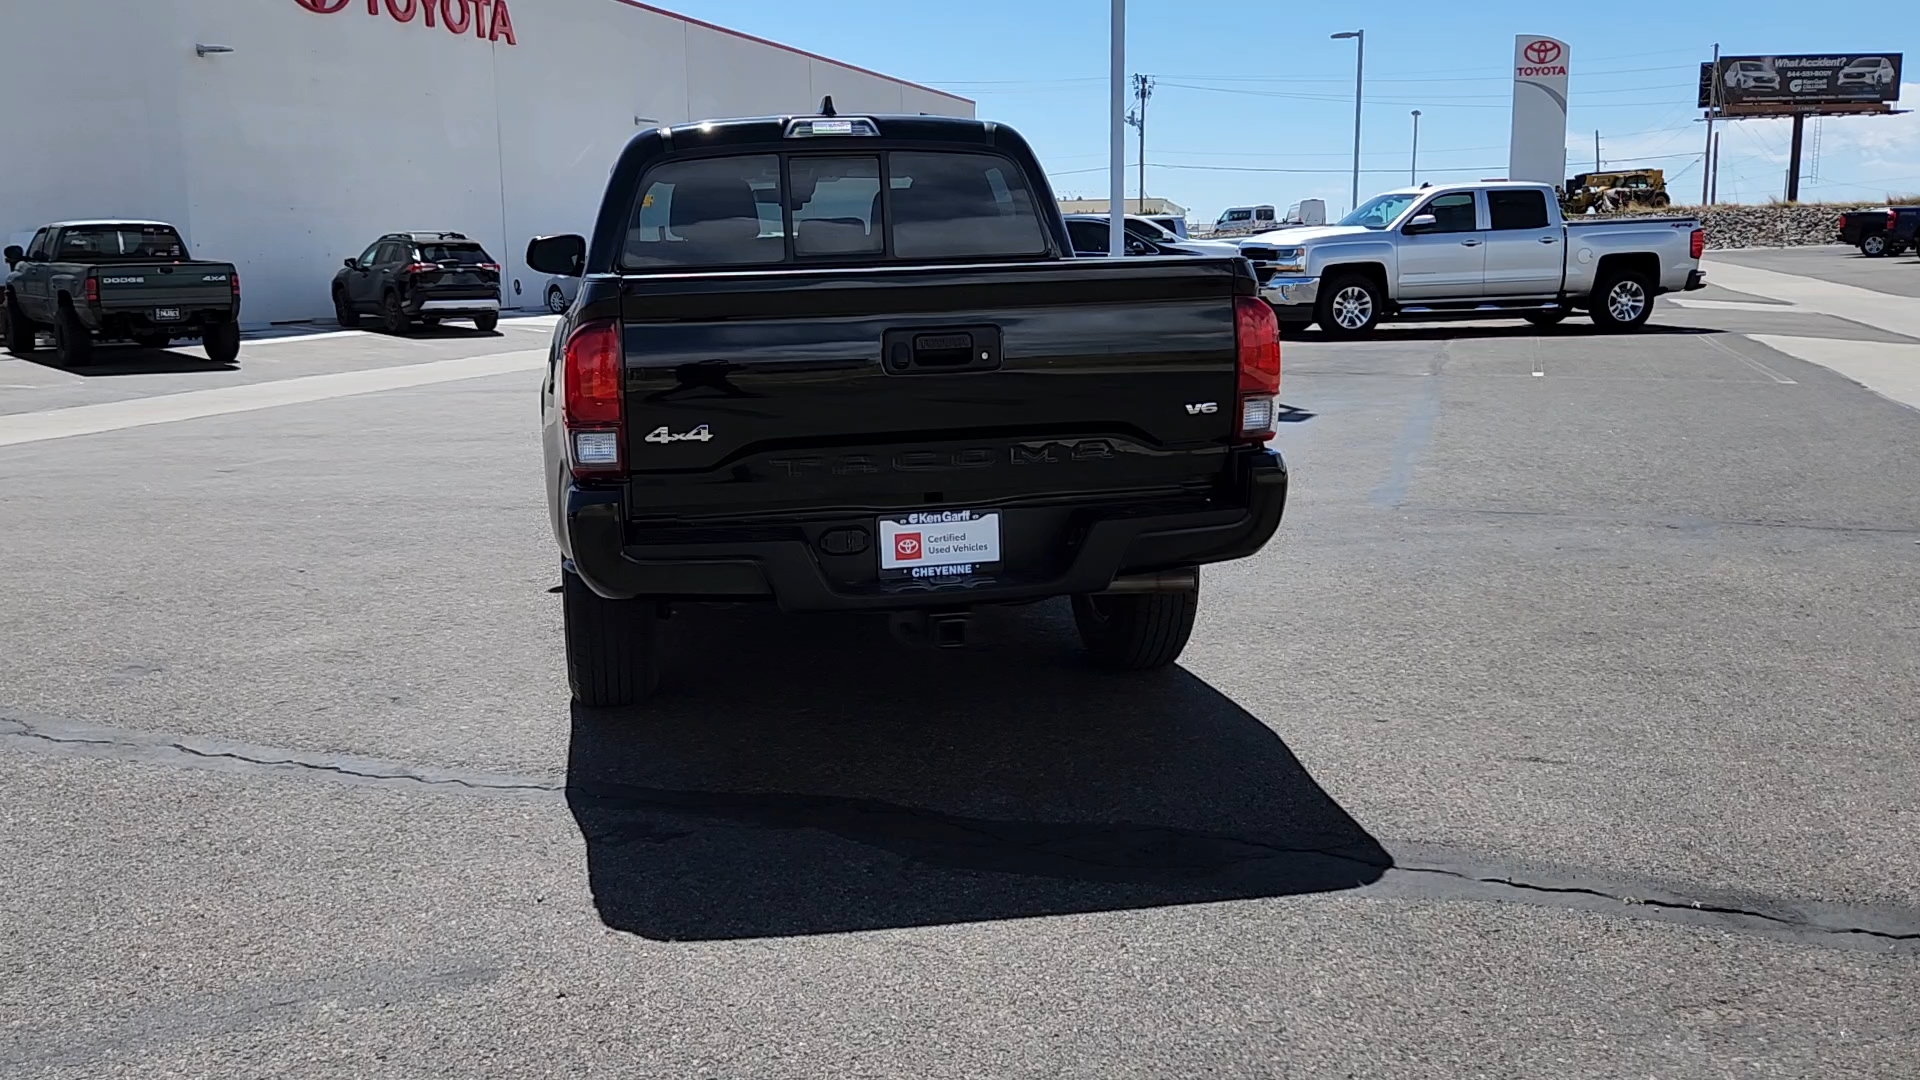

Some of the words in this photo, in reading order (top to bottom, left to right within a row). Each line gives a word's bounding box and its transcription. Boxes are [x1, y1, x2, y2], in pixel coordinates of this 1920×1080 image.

[1774, 58, 1798, 68] What
[1799, 56, 1847, 67] Accident?
[1516, 66, 1567, 77] TOYOTA
[103, 276, 145, 284] DODGE
[1185, 402, 1219, 415] V6
[769, 439, 1115, 476] TACOMA
[919, 512, 941, 524] Ken
[942, 510, 971, 522] Garff
[927, 532, 967, 544] Certified
[928, 545, 951, 555] Used
[952, 543, 988, 553] Vehicles
[911, 564, 972, 578] CHEYENNE
